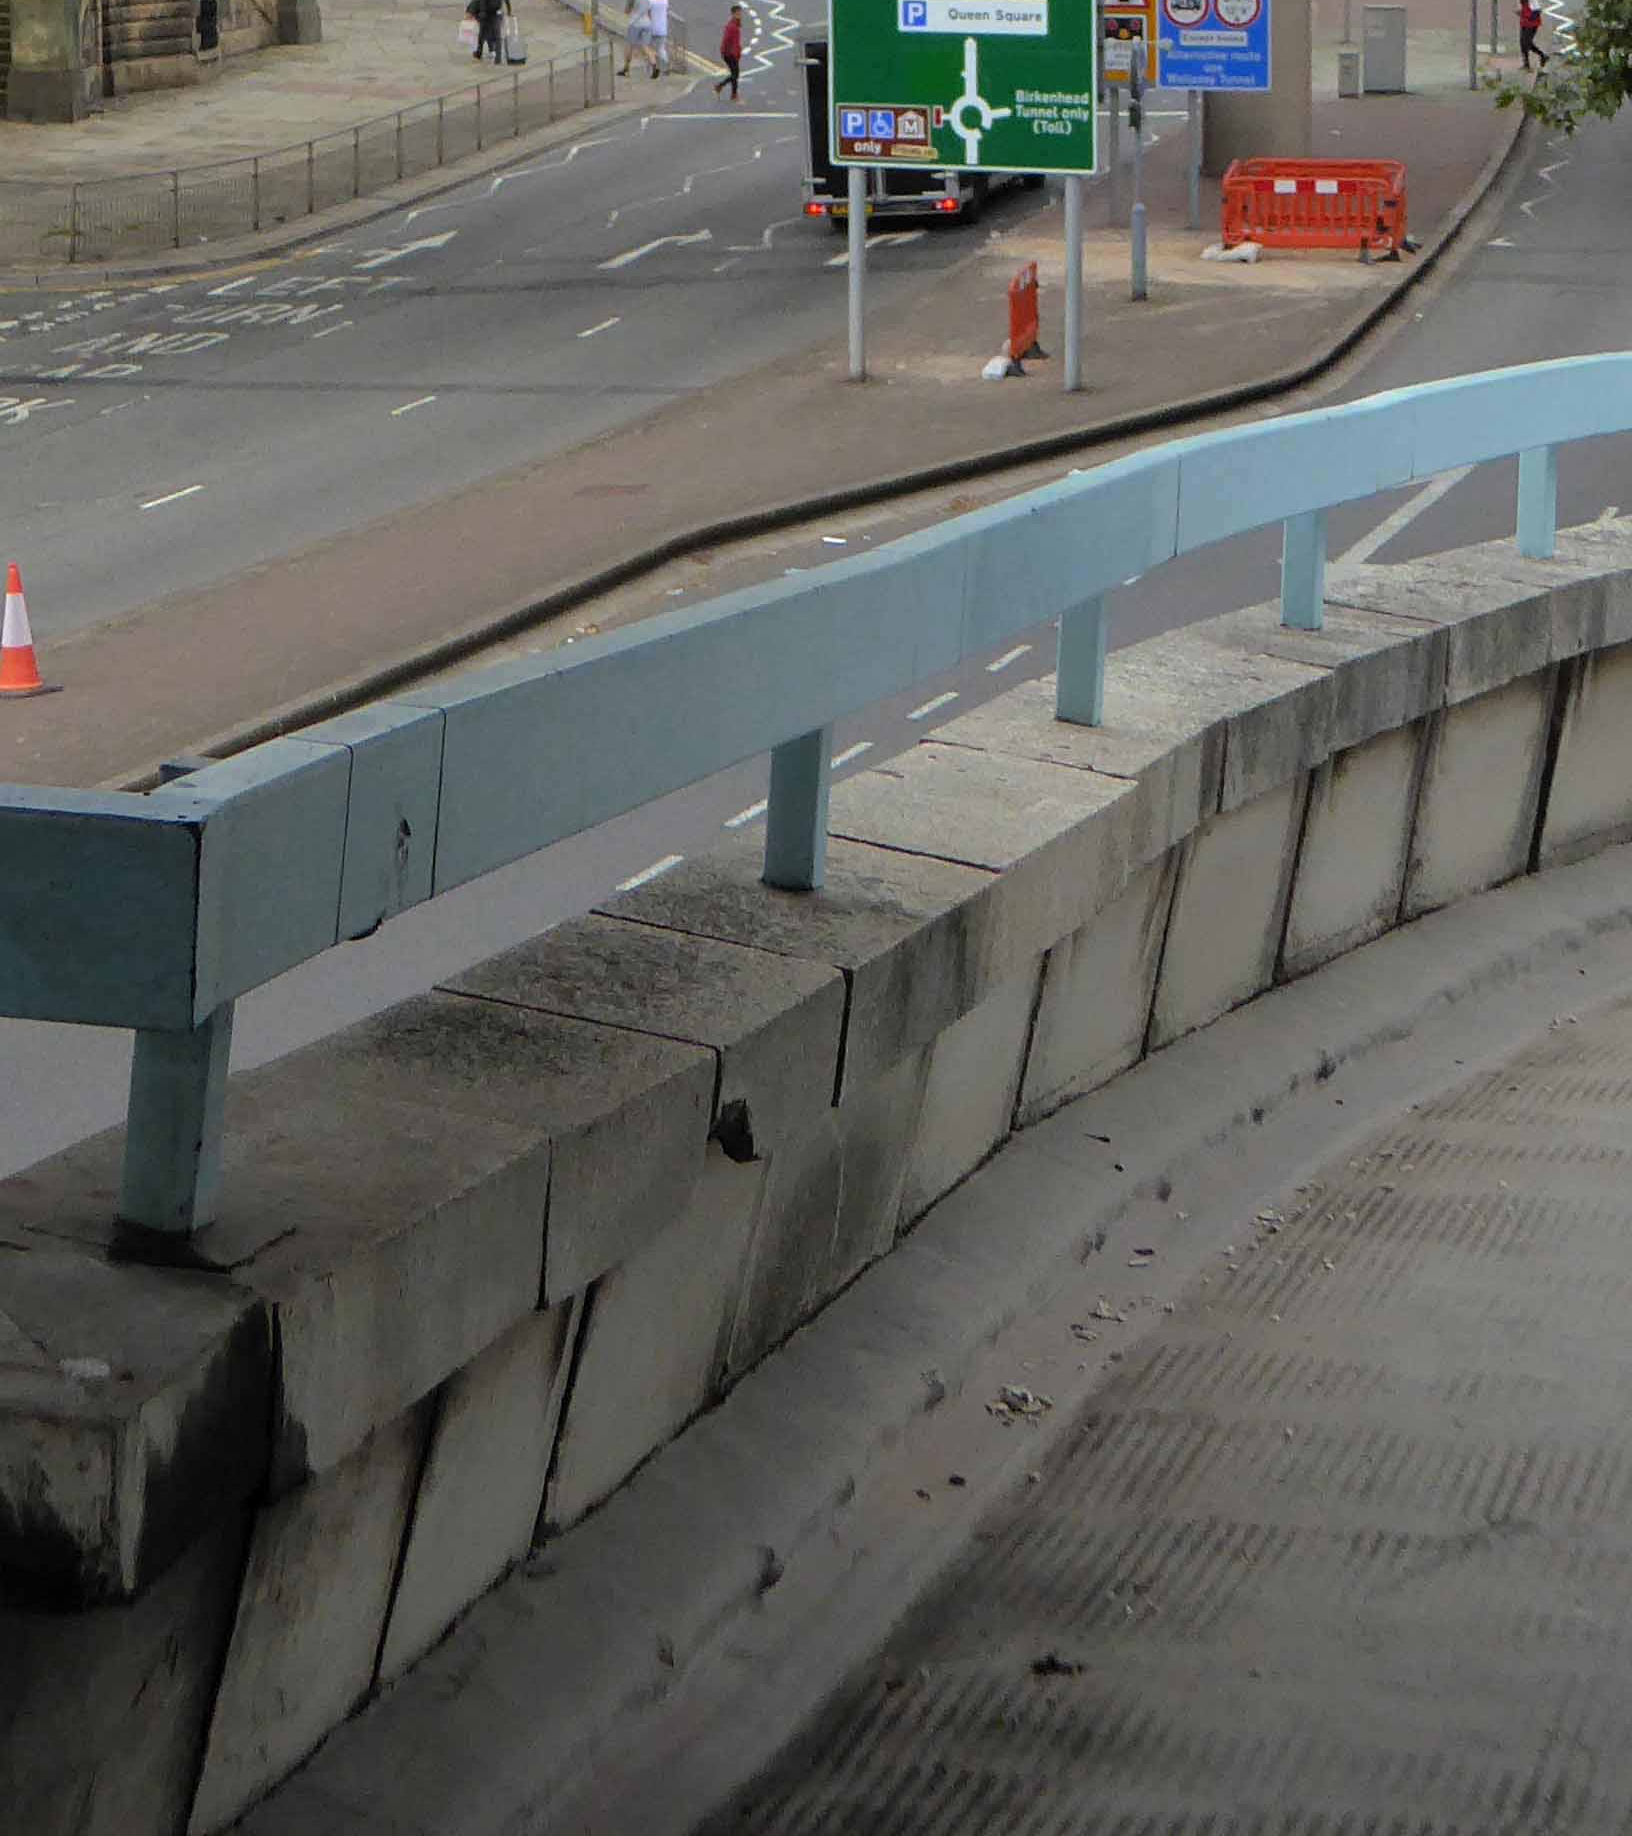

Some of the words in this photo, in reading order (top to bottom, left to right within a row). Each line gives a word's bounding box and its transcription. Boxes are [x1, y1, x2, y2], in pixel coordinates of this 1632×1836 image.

[948, 8, 990, 21] Queen
[995, 9, 1042, 23] Square
[1016, 90, 1089, 105] Birkenhead
[1016, 104, 1058, 118] Tunnel
[1061, 107, 1090, 122] only
[1033, 120, 1072, 135] (Toll)
[854, 141, 882, 155] only
[208, 276, 418, 297] LEFT
[52, 332, 230, 355] AND
